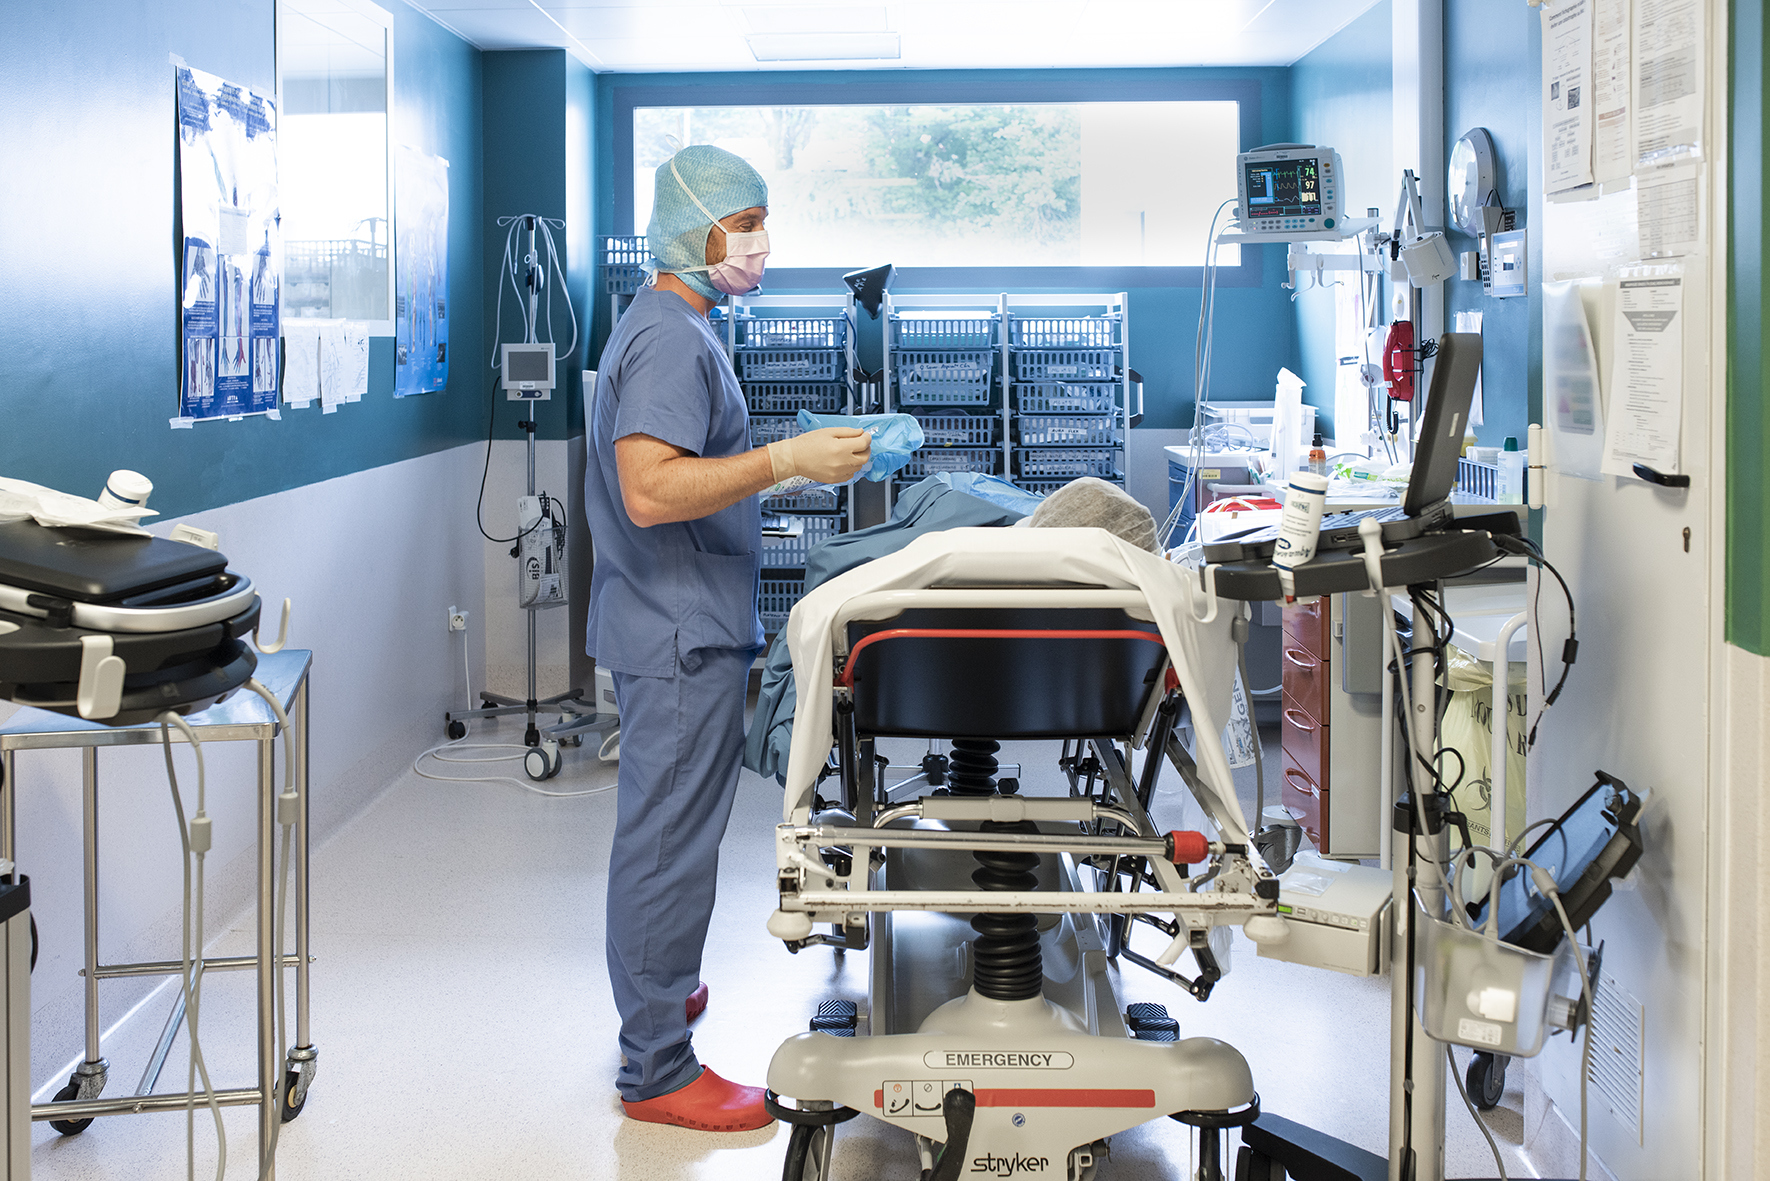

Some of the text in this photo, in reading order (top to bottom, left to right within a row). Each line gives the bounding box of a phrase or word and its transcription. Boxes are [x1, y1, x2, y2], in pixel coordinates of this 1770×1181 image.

[1305, 167, 1314, 176] 74
[1305, 180, 1315, 189] 97
[945, 1053, 1052, 1067] EMERGENCY
[971, 1152, 1049, 1177] stryker
